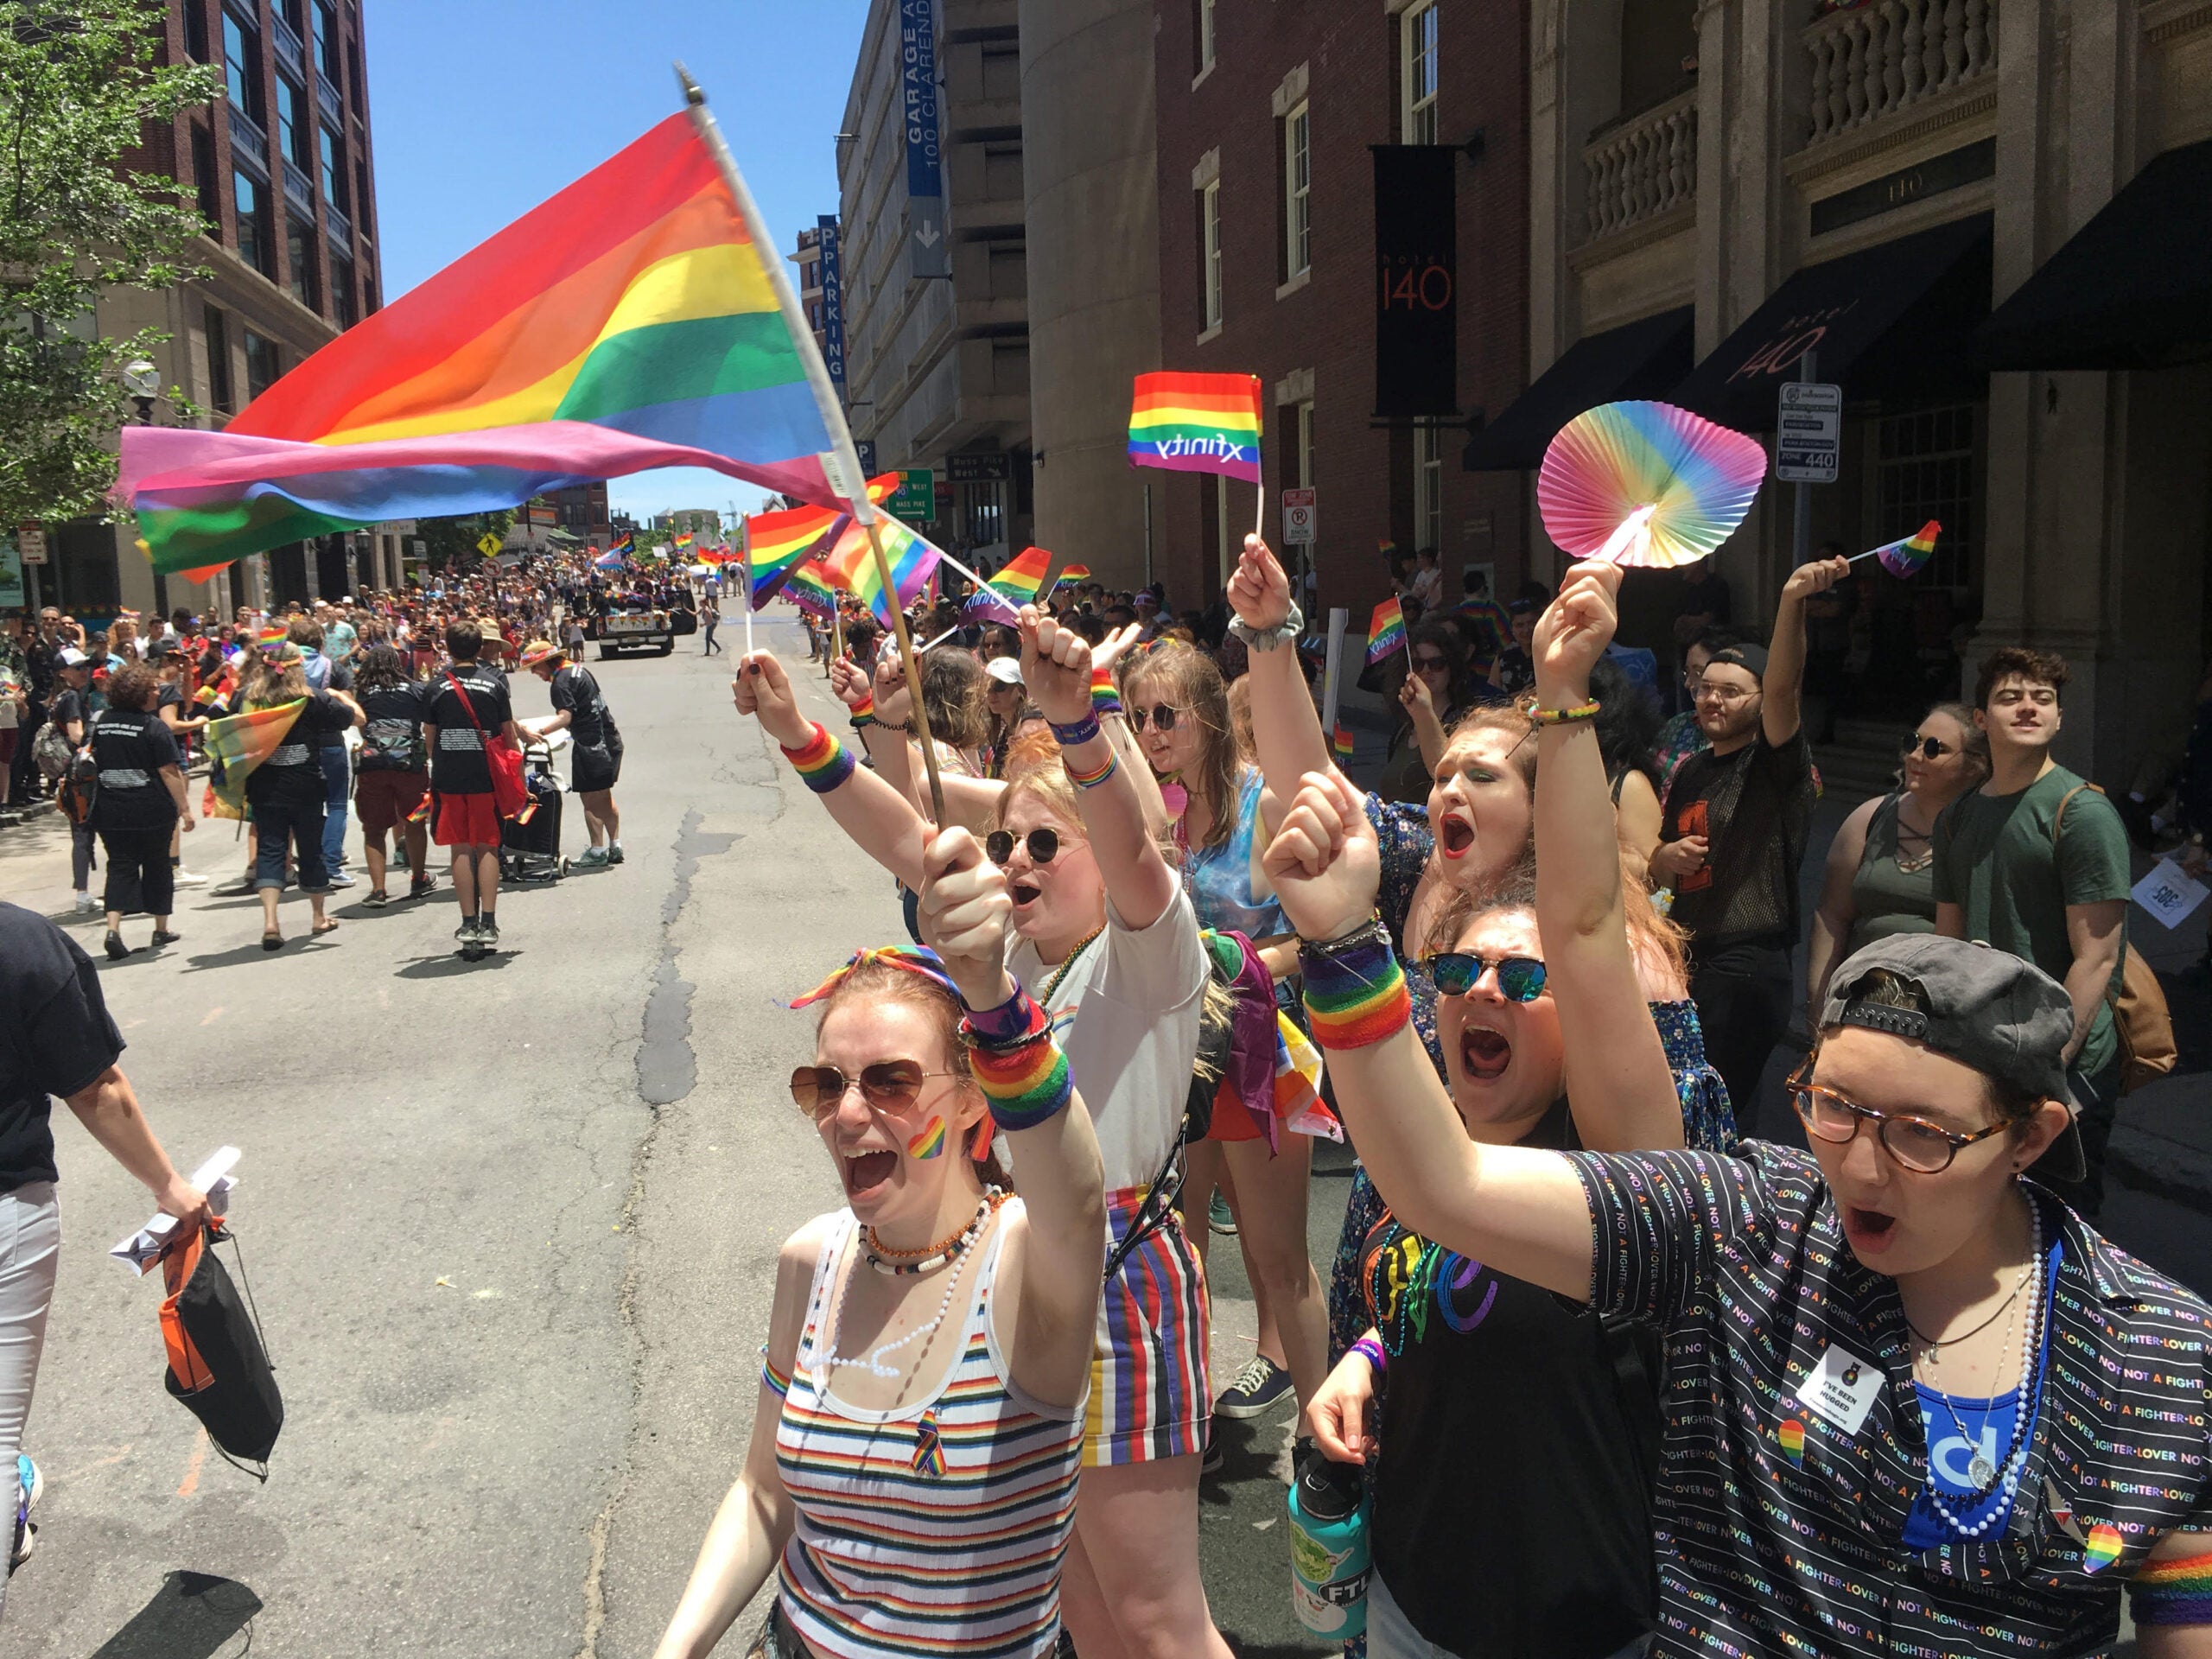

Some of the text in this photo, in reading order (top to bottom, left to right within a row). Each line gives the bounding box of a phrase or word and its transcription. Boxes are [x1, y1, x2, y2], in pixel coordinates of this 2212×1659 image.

[904, 27, 922, 144] GARAGE
[925, 129, 938, 168] 100
[822, 227, 835, 245] P
[1383, 264, 1452, 310] 140
[824, 251, 842, 376] PARKING
[1726, 326, 1827, 384] 140
[1805, 454, 1834, 467] 440
[954, 469, 978, 478] West
[1780, 1160, 1802, 1171] NOT
[1709, 1207, 1720, 1230] NOT
[1724, 1245, 1743, 1263] NOT
[1811, 1292, 1820, 1302] A
[1732, 1305, 1755, 1327] NOT
[2083, 1306, 2106, 1327] NOT
[2175, 1310, 2200, 1323] NOT
[1795, 1321, 1816, 1339] NOT
[2098, 1354, 2121, 1376] NOT
[2124, 1368, 2149, 1382] NOT
[1820, 1390, 1850, 1412] HUGGED
[1837, 1389, 1858, 1405] BEEN
[1781, 1395, 1800, 1413] NOT
[1799, 1409, 1808, 1421] A
[2051, 1441, 2072, 1465] NOT
[1835, 1472, 1853, 1493] NOT
[1873, 1468, 1897, 1489] NOT
[1791, 1518, 1815, 1538] NOT
[2118, 1522, 2146, 1535] NOT
[1668, 1615, 1688, 1632] NOT
[1837, 1618, 1862, 1637] NOT
[1897, 1599, 1921, 1614] NOT
[2017, 1634, 2038, 1648] NOT
